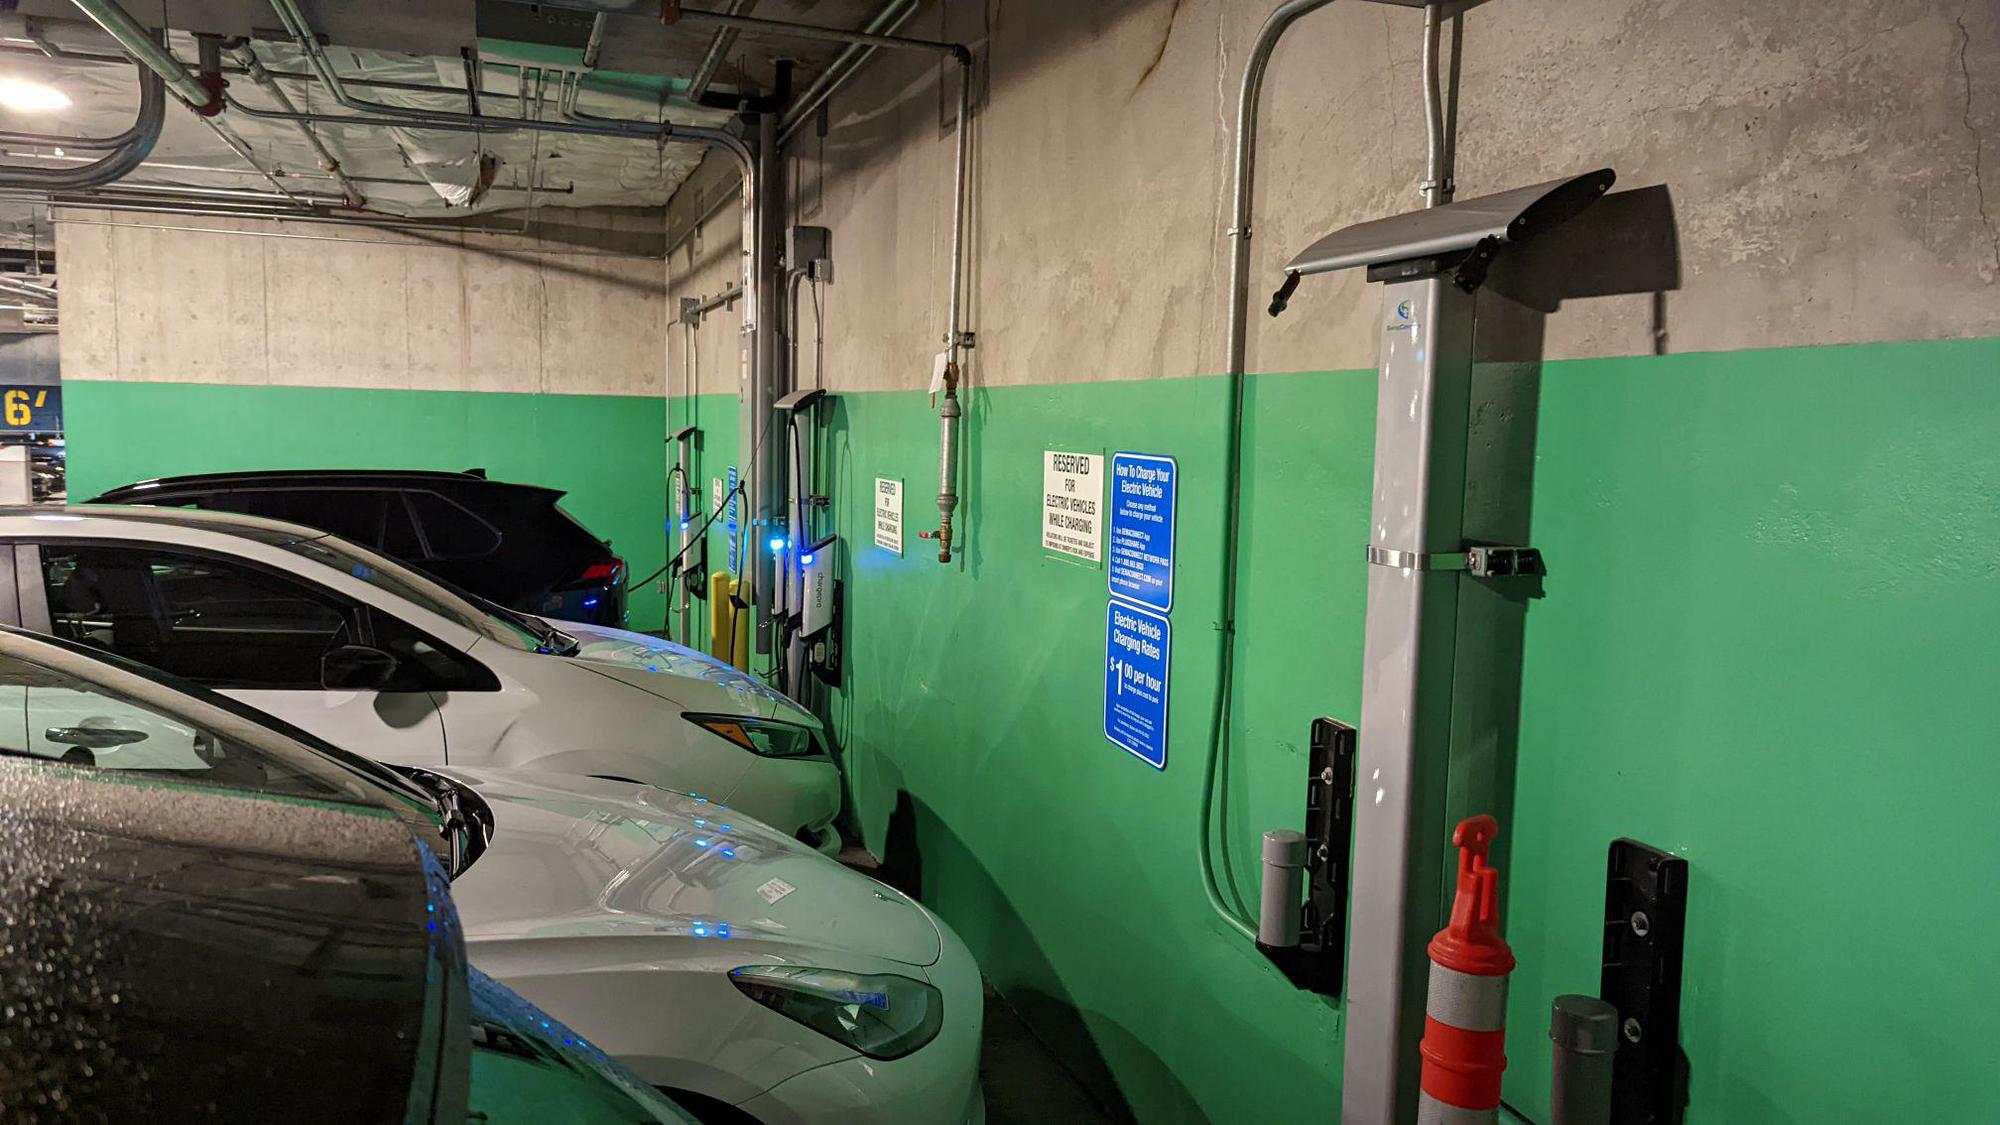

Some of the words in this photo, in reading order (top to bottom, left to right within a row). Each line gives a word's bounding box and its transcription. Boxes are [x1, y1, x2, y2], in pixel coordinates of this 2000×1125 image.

[1053, 454, 1090, 475] RESERVED
[1116, 463, 1129, 477] How
[1129, 464, 1136, 478] To
[1136, 465, 1156, 483] Charge
[1156, 468, 1170, 482] Your
[1065, 478, 1075, 492] FOR
[1121, 480, 1141, 495] Electric
[1142, 483, 1163, 499] Vehicle
[1047, 494, 1069, 510] ELECTRIC
[1070, 498, 1095, 515] VEHICLES
[1049, 512, 1064, 528] WHILE
[1065, 516, 1092, 534] CHARGING
[816, 572, 824, 609] chargepro
[1114, 610, 1137, 632] Electric
[1137, 619, 1161, 640] Vehicle
[1114, 628, 1141, 655] Charging
[1141, 640, 1160, 660] Rates
[1134, 670, 1145, 685] per
[1146, 672, 1161, 693] hour
